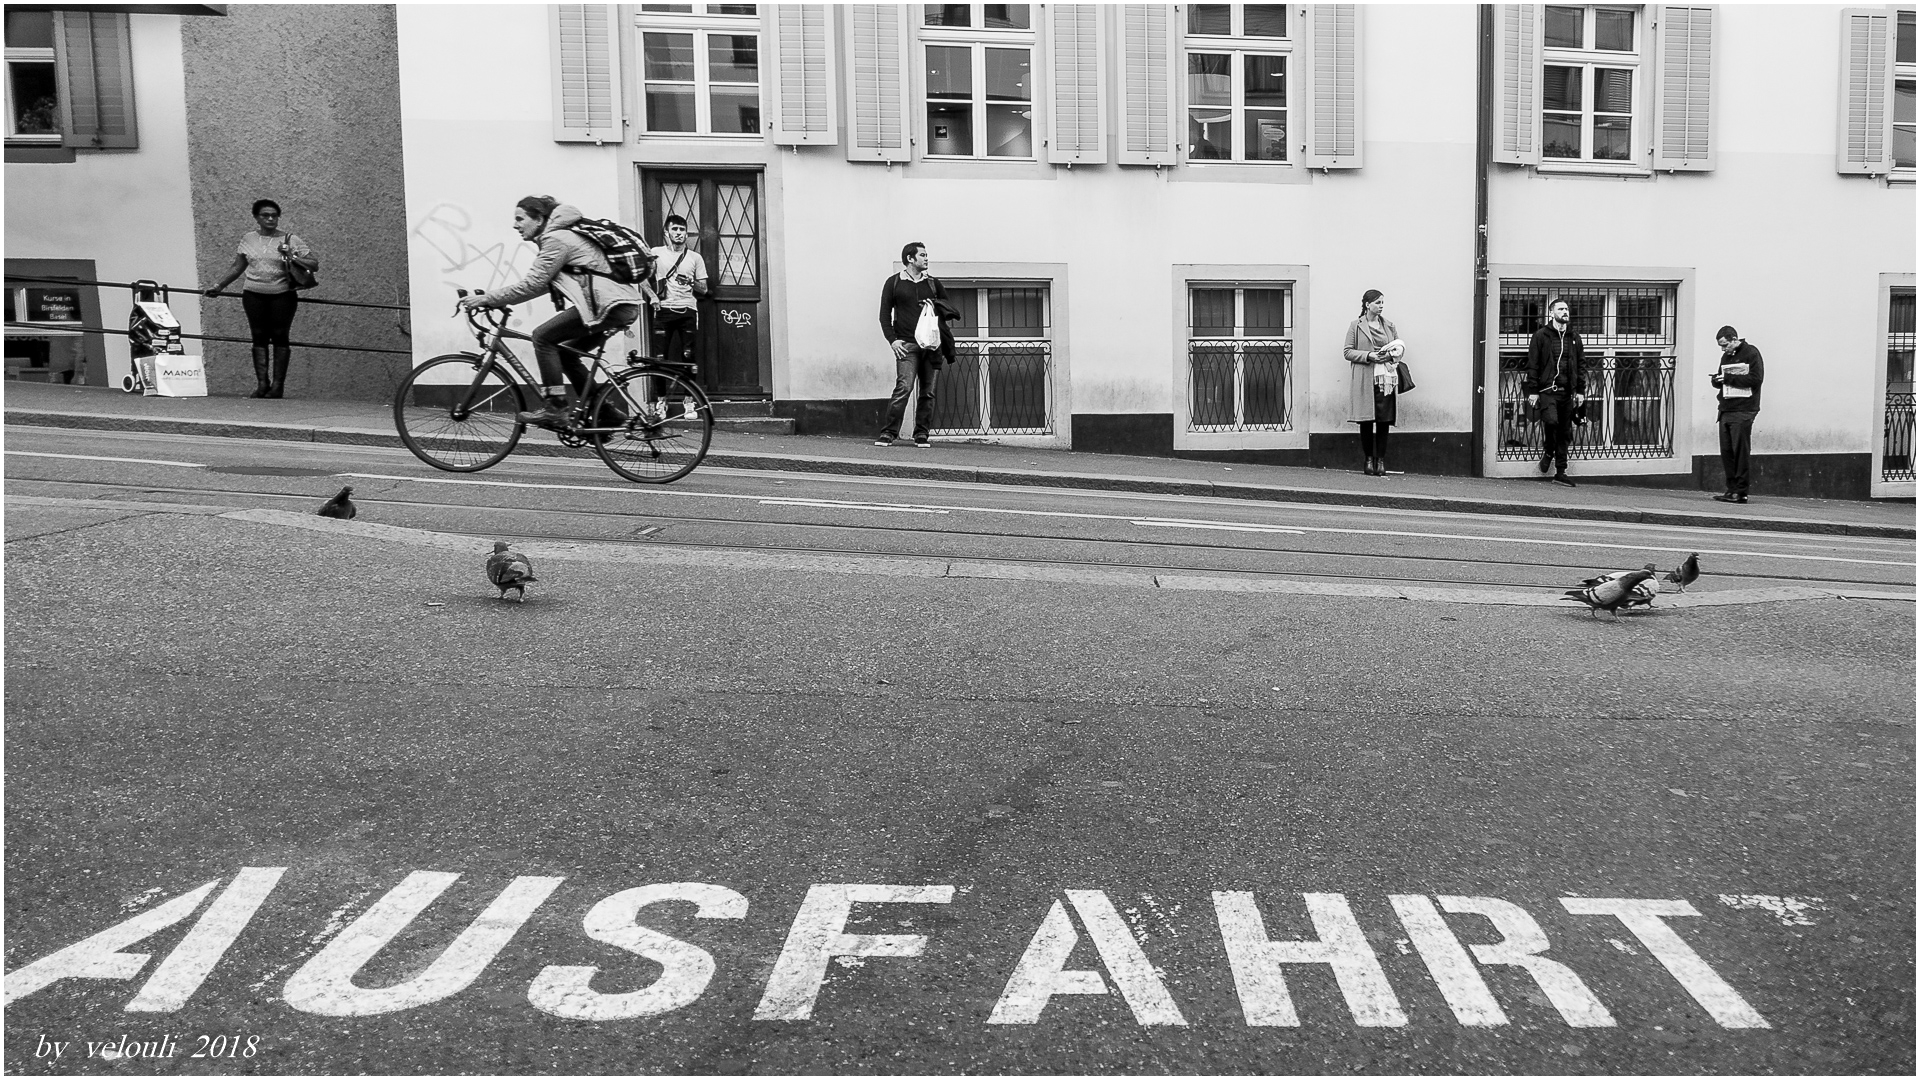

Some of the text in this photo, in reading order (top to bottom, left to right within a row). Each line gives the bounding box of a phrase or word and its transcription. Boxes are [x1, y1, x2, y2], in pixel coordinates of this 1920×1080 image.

[43, 294, 72, 302] Kurse in
[163, 369, 200, 377] MANOR
